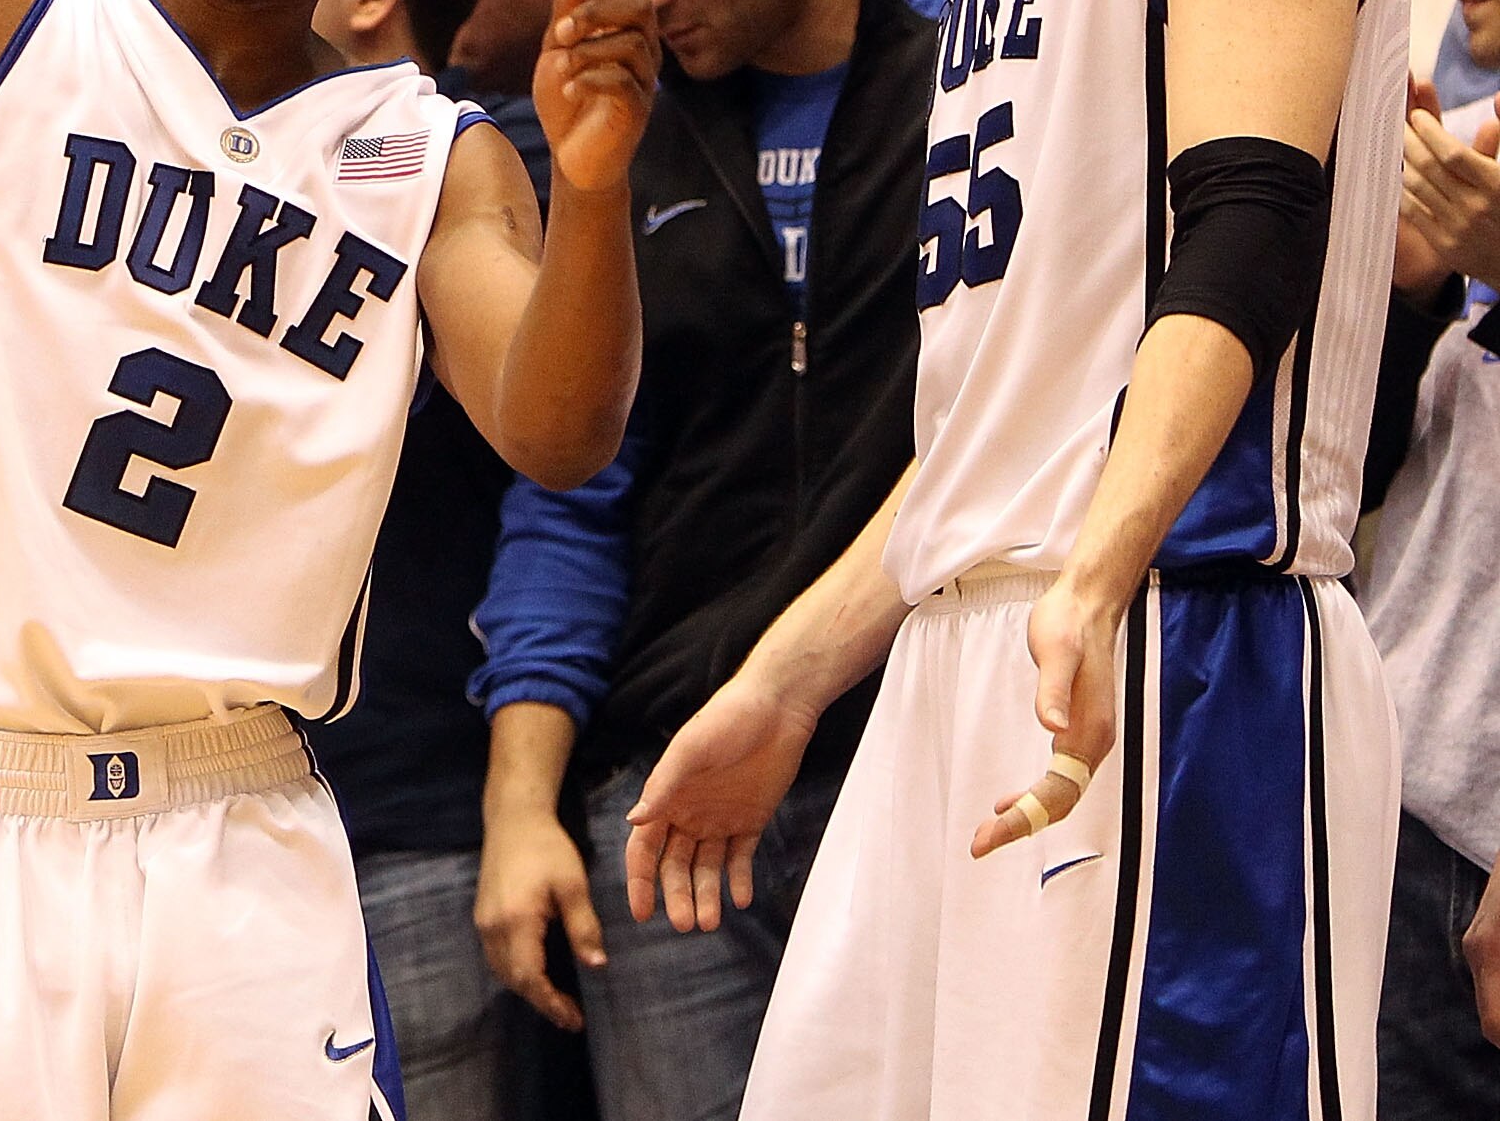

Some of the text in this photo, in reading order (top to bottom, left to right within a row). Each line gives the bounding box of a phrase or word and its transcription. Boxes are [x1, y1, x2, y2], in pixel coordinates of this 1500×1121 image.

[43, 133, 409, 381] DUKE
[916, 101, 1023, 313] 55
[62, 347, 233, 549] 2
[86, 751, 140, 801] D
